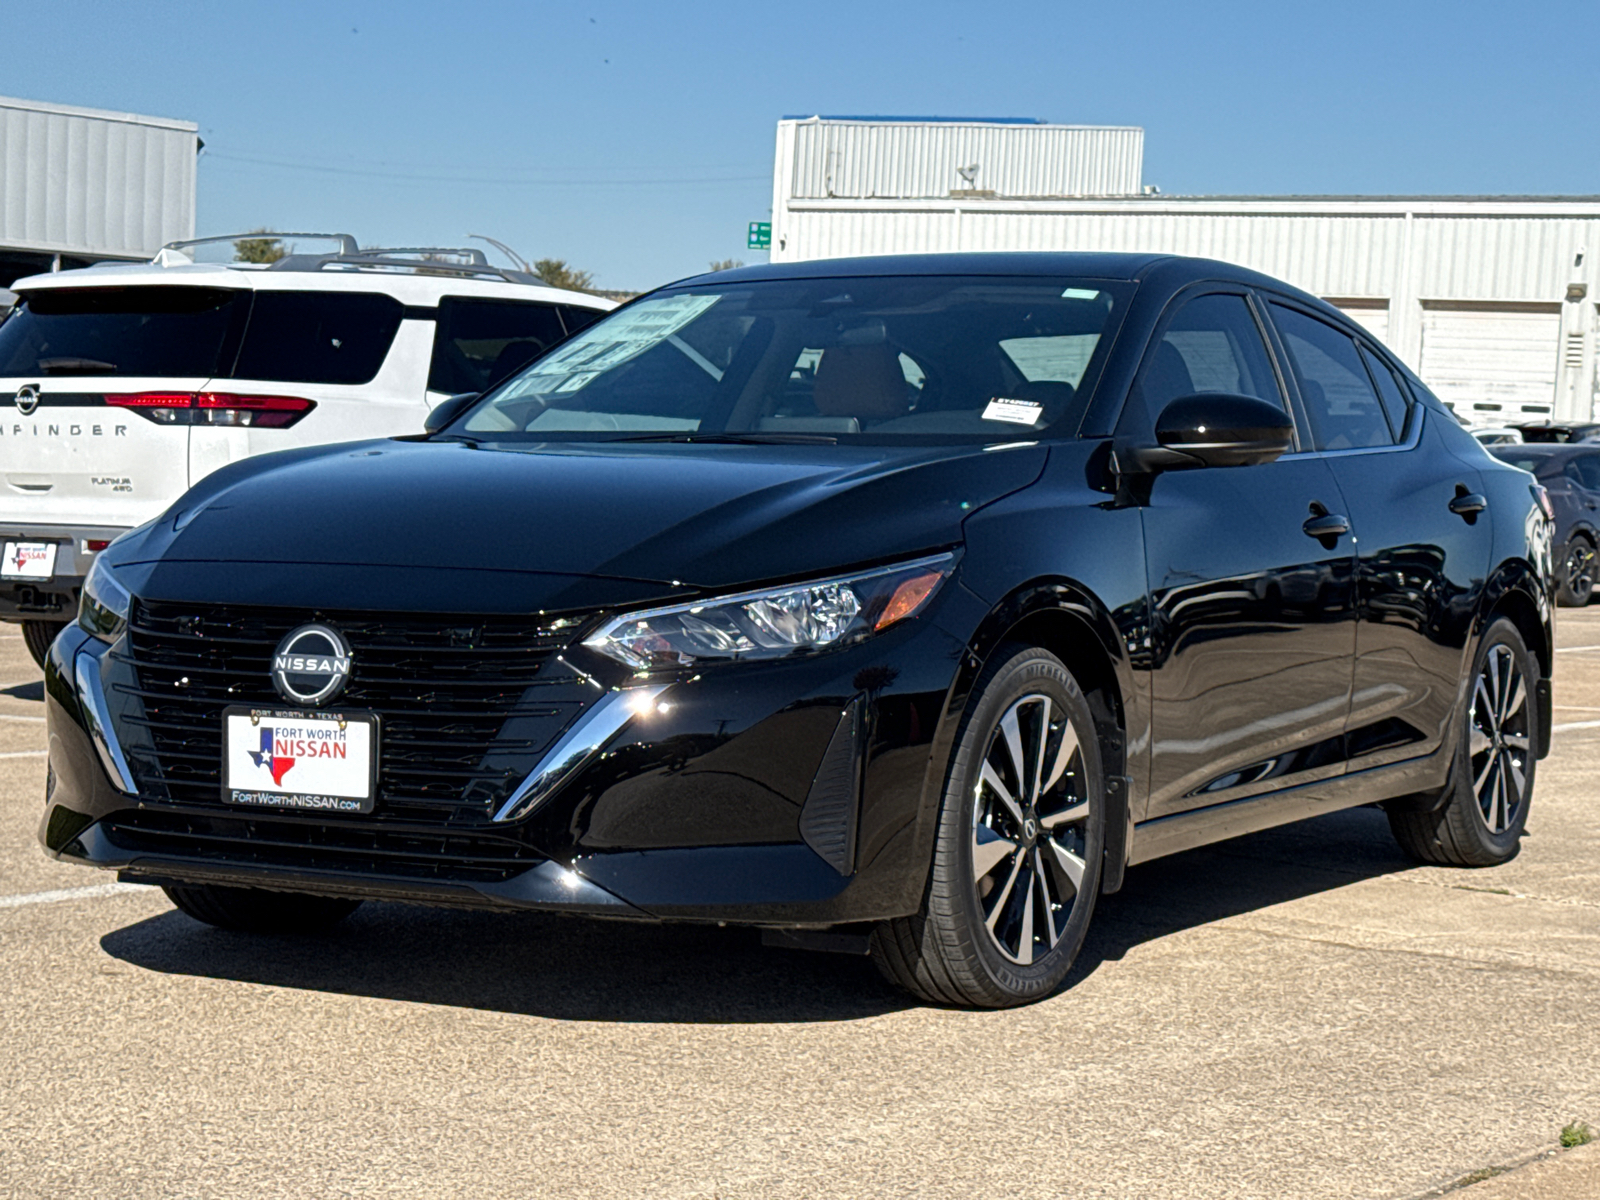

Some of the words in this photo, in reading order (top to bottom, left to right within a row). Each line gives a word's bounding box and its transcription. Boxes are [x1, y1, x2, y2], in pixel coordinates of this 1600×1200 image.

[91, 477, 131, 485] PLATINUM
[275, 657, 347, 672] NISSAN
[1026, 664, 1076, 694] MICHELIN
[251, 709, 272, 717] FORT
[275, 711, 304, 719] WORTH
[316, 712, 343, 721] TEXAS
[275, 727, 303, 739] FORT
[306, 728, 346, 741] WORTH
[275, 739, 346, 759] NISSAN
